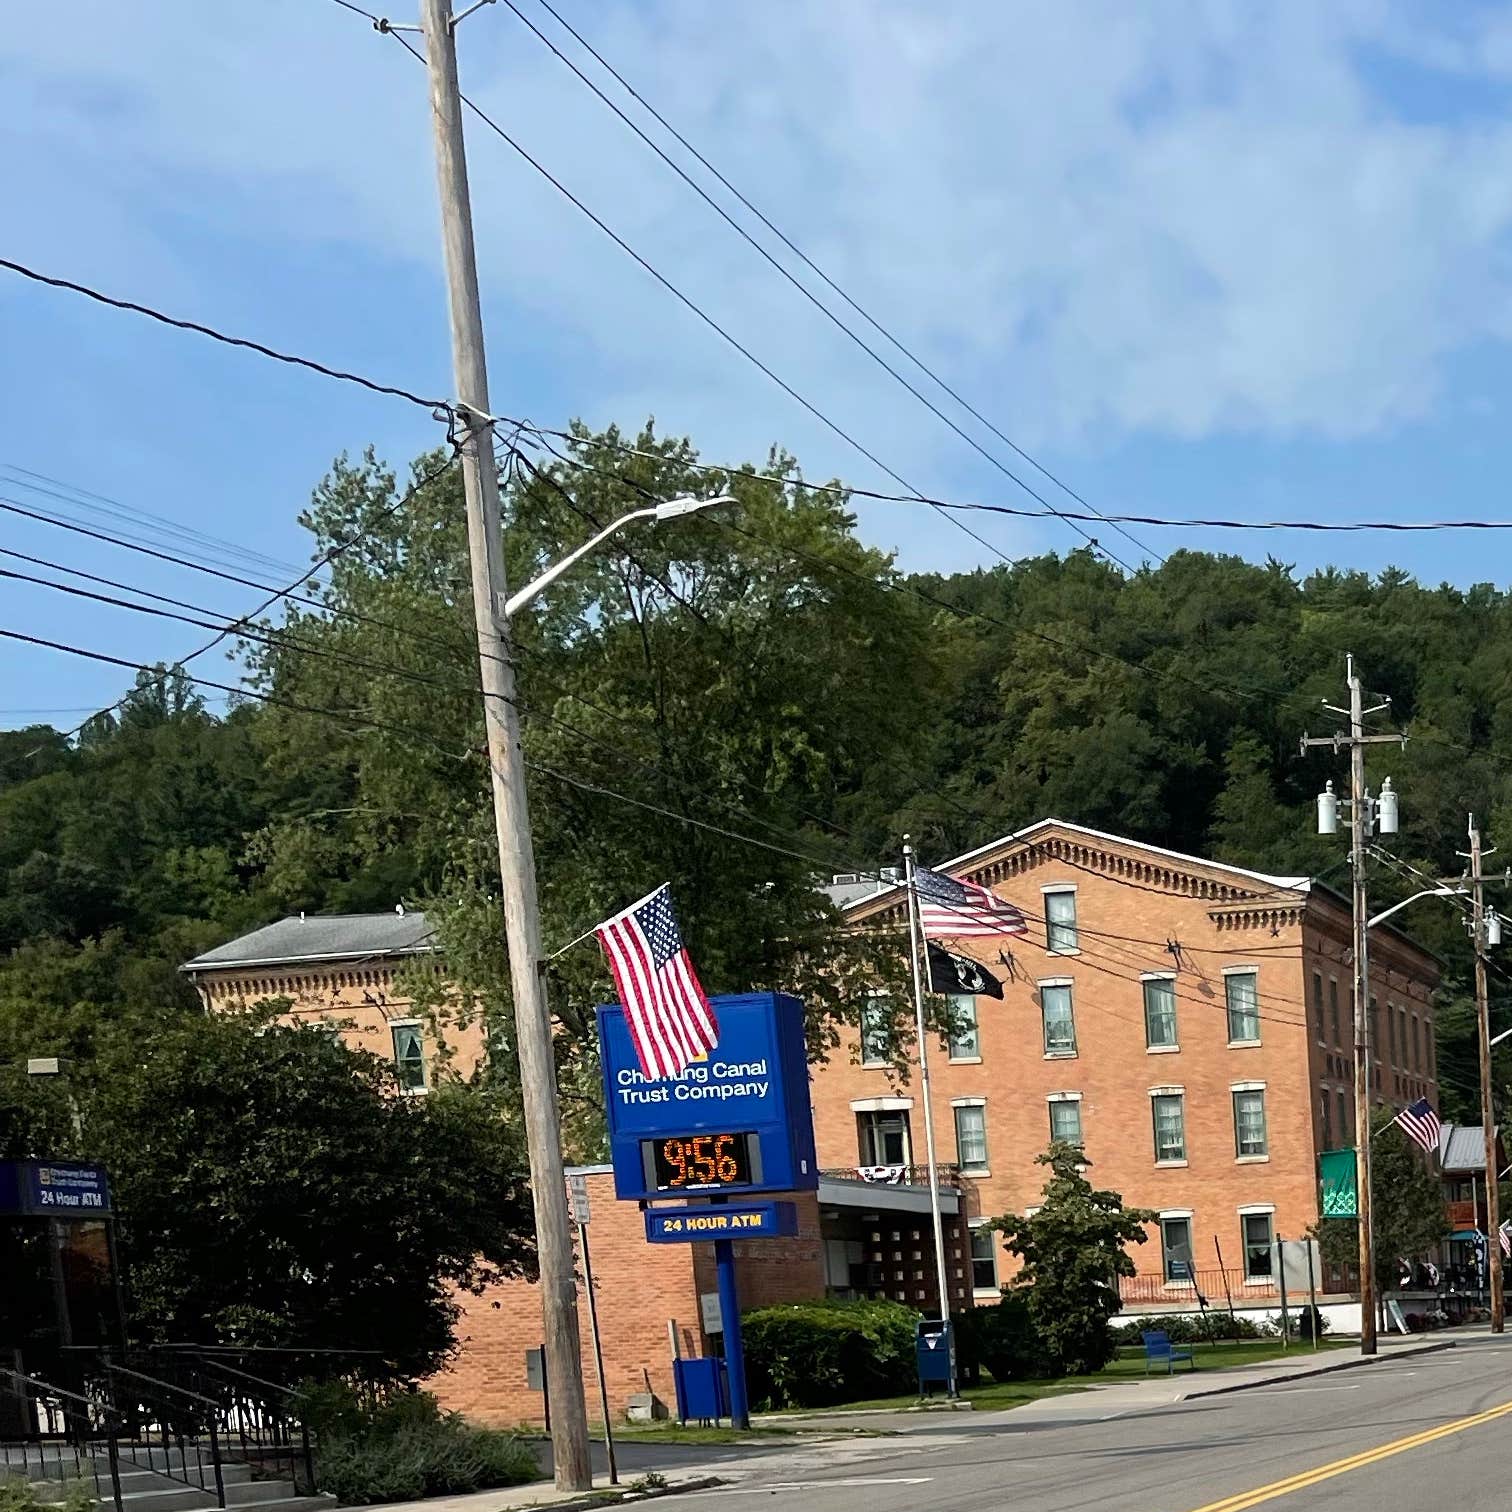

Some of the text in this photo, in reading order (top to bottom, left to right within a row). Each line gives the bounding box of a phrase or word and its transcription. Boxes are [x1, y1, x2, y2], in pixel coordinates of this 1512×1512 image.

[617, 1058, 768, 1085] Chung Canal
[617, 1081, 769, 1104] Trust Company
[663, 1135, 737, 1186] 9:56
[41, 1190, 55, 1205] 24
[82, 1192, 102, 1207] ATM
[663, 1214, 762, 1232] 24 HOUR ATM
